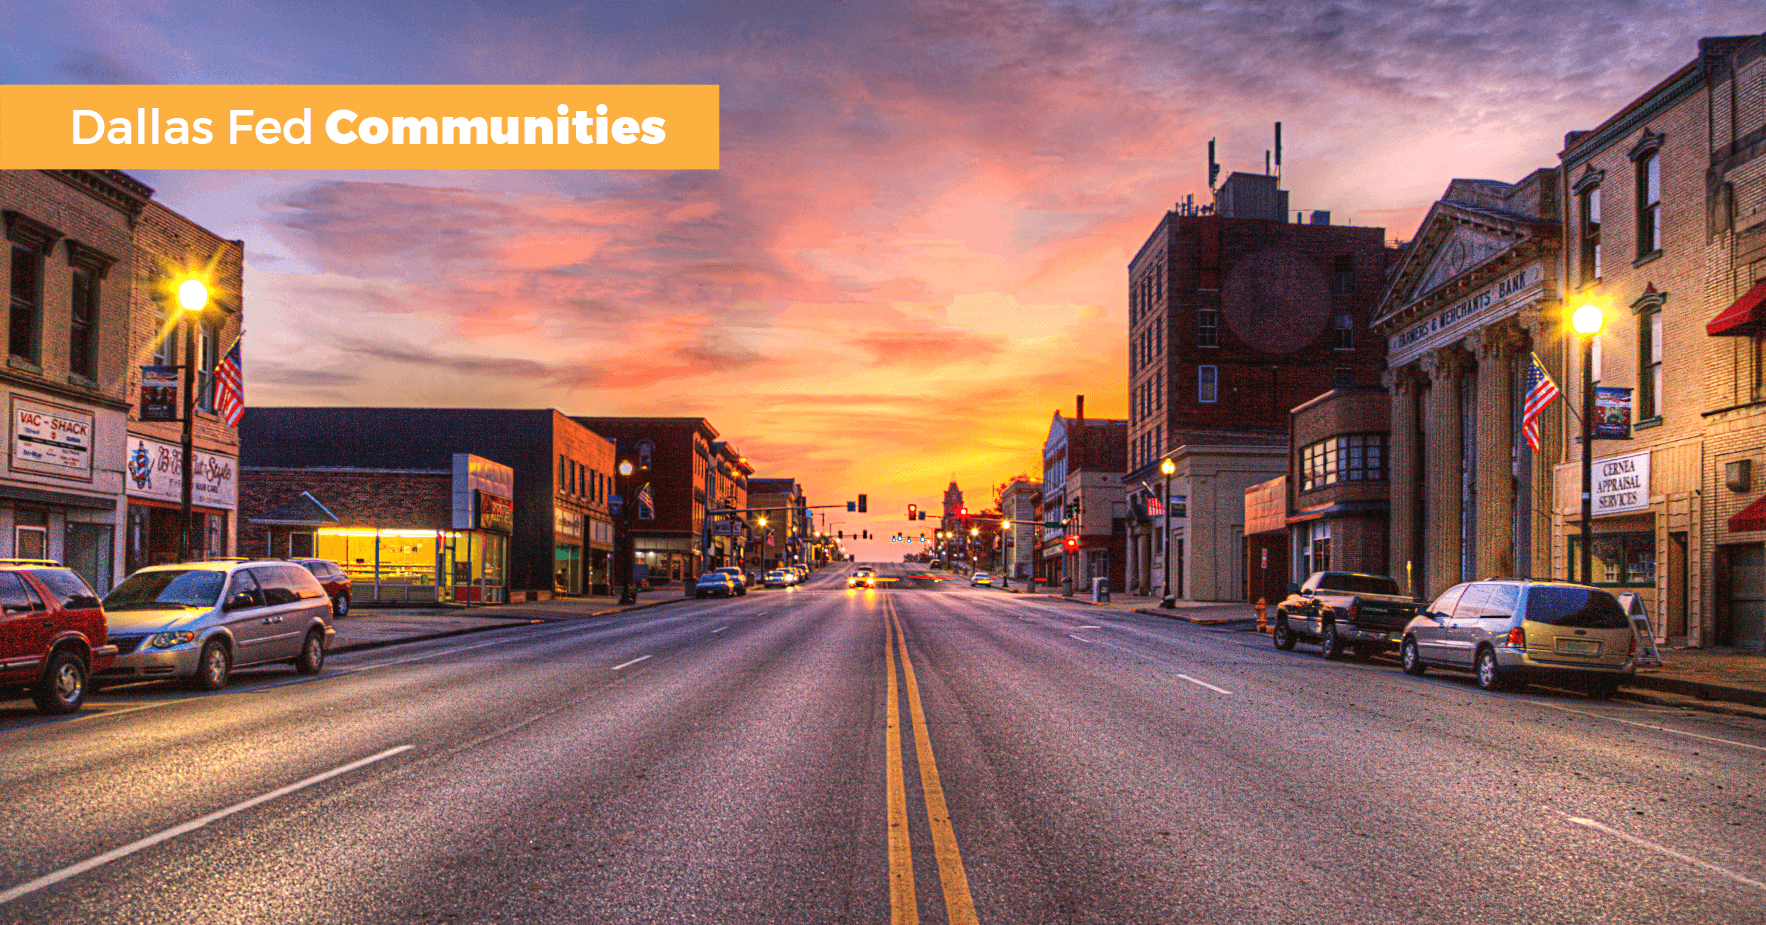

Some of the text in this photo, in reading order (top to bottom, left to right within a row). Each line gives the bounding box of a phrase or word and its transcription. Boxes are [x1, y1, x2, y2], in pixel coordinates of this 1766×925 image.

[1398, 270, 1526, 347] FARMERS & MERCHANTS BANK
[20, 411, 42, 427] VAC
[50, 418, 88, 436] SHACK
[1602, 459, 1636, 478] CERNEA
[1596, 474, 1641, 494] APPRAISAL
[1599, 491, 1638, 509] SERVICES
